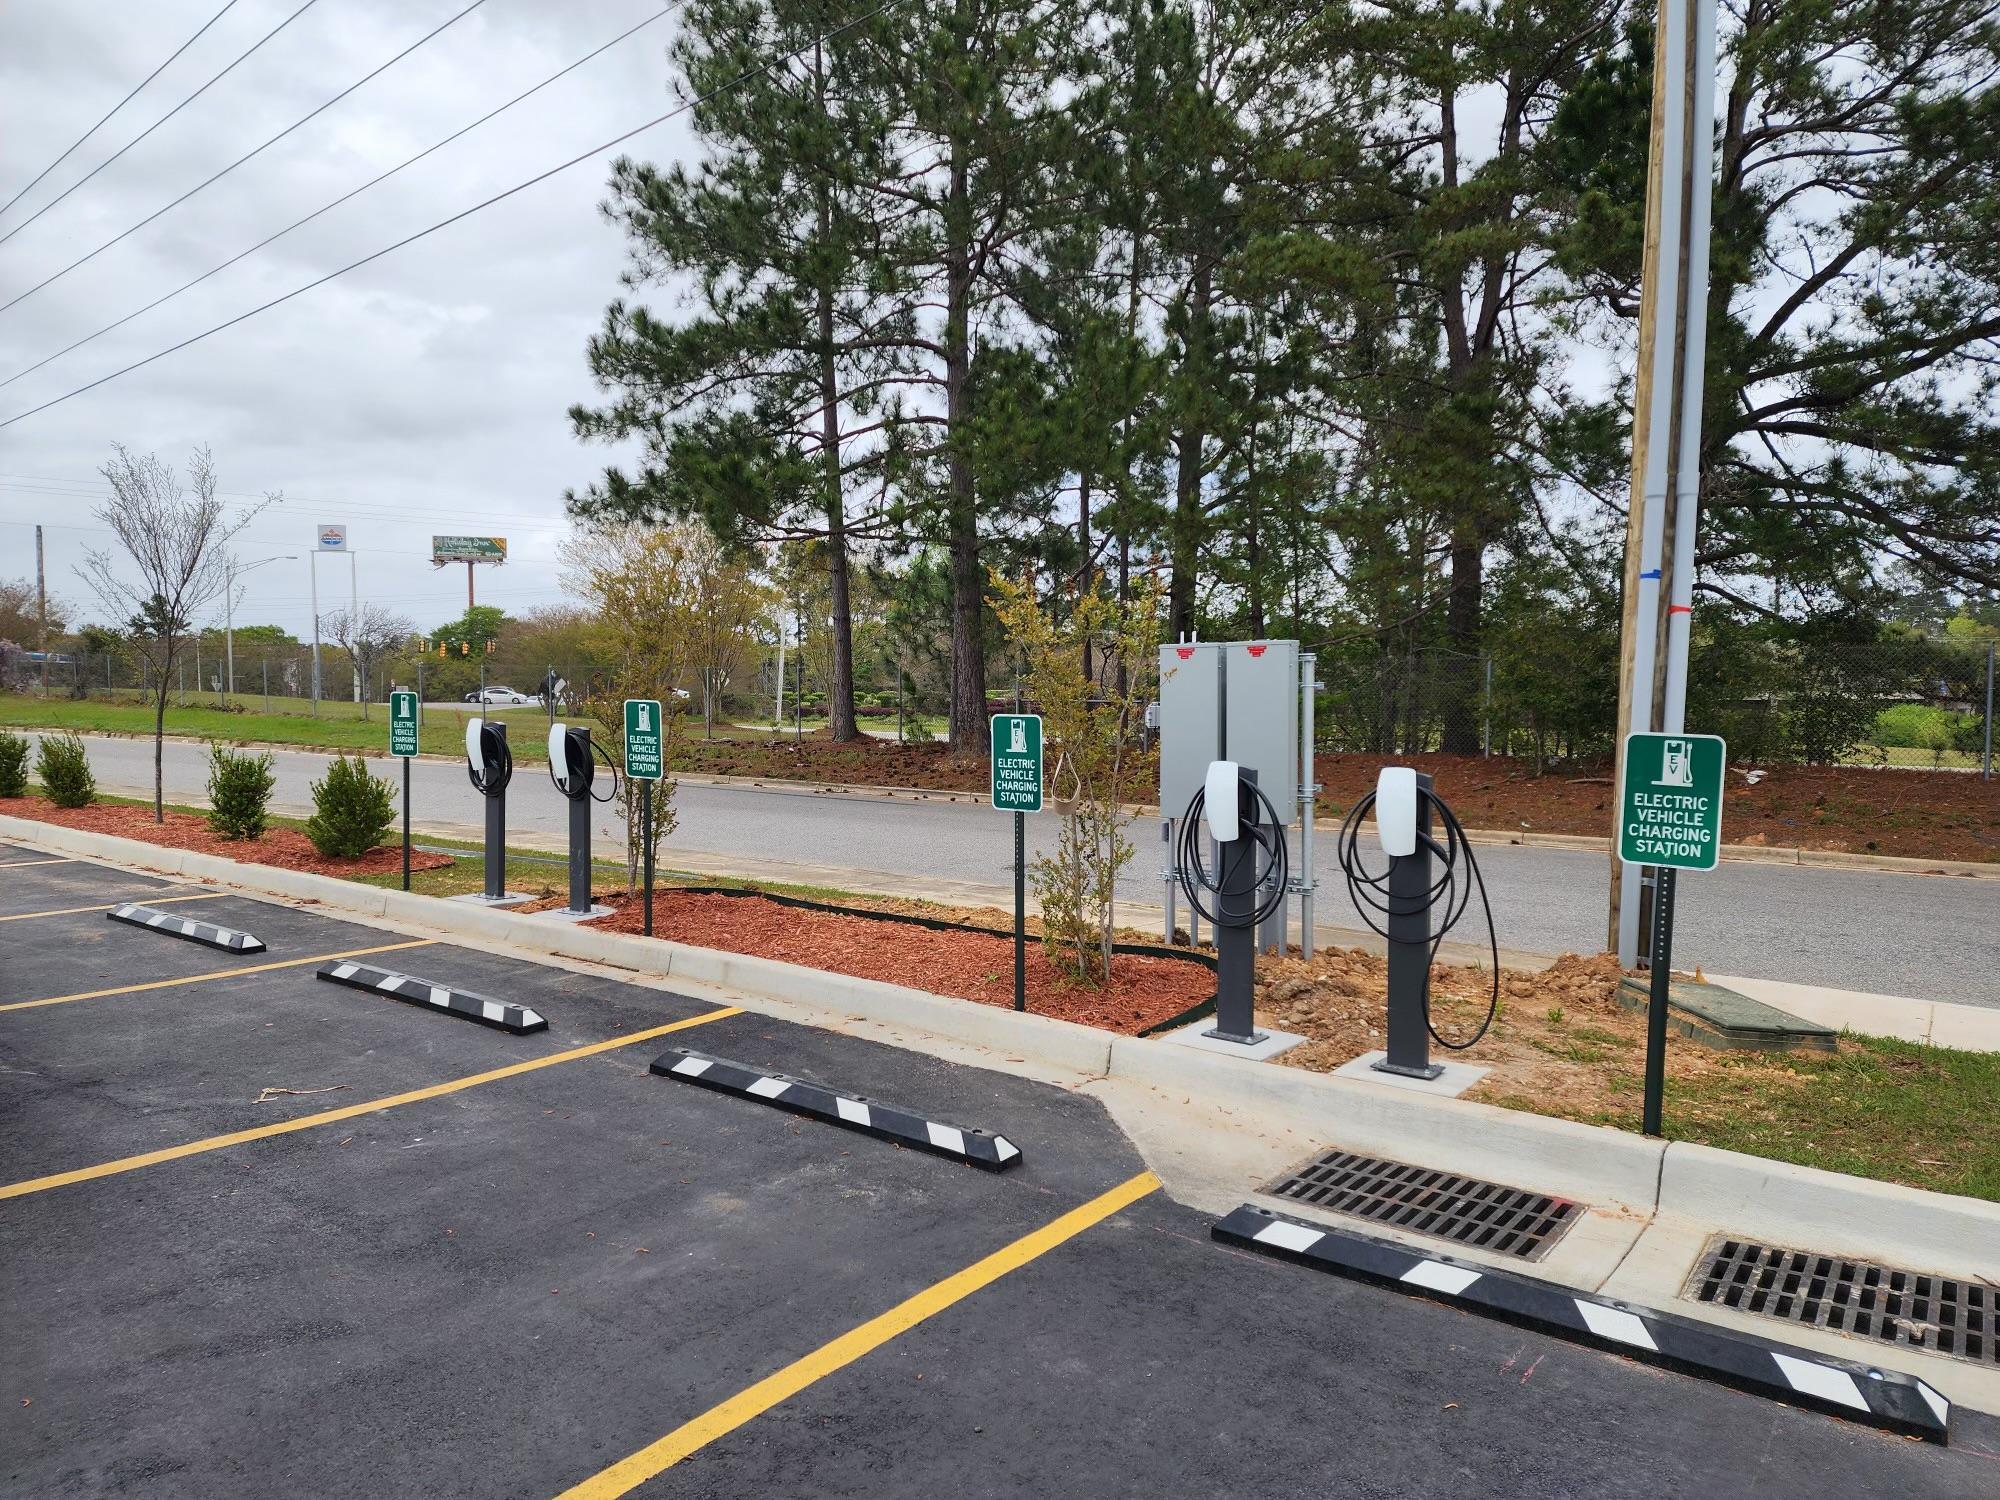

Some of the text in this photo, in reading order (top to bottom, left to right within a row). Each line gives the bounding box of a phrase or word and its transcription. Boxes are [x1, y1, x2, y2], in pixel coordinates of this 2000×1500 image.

[393, 736, 416, 744] CHARGING
[629, 735, 658, 744] ELECTRIC
[395, 743, 414, 751] STATION
[631, 745, 657, 754] VEHICLE
[628, 754, 660, 763] CHARGING
[998, 758, 1036, 769] ELECTRIC
[632, 762, 657, 772] STATION
[1000, 769, 1034, 781] VEHICLE
[996, 780, 1038, 792] CHARGING
[1000, 791, 1034, 803] STATION
[1634, 792, 1708, 811] ELECTRIC
[1637, 808, 1704, 826] VEHICLE
[1628, 823, 1711, 843] CHARGING
[1635, 839, 1702, 858] STATION
